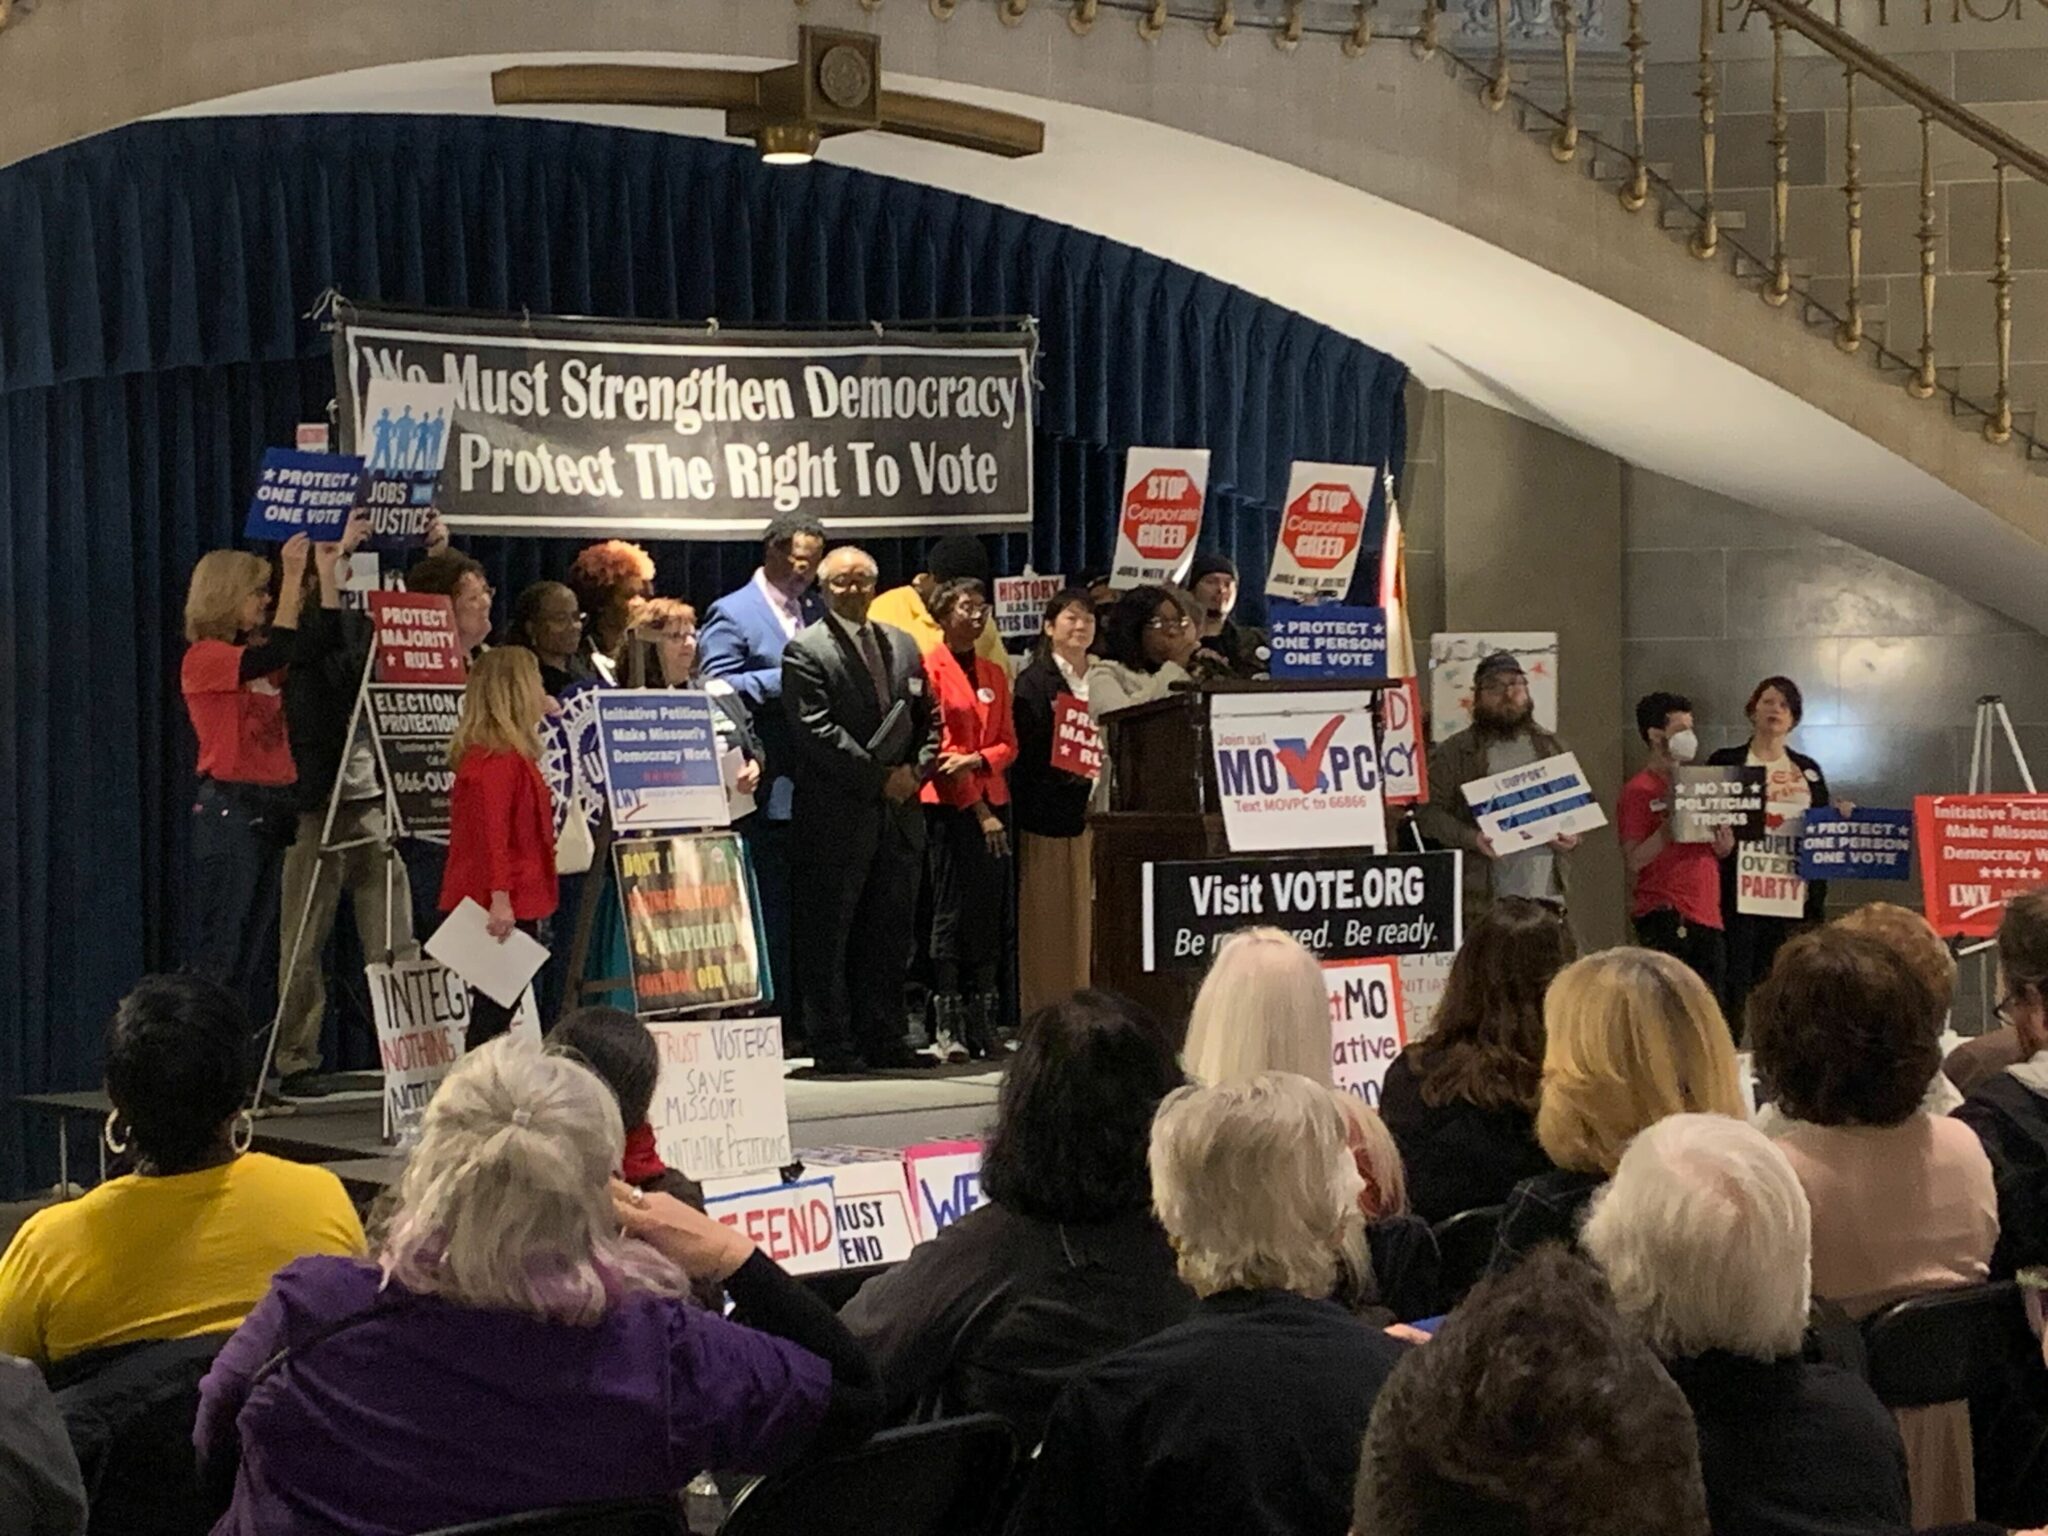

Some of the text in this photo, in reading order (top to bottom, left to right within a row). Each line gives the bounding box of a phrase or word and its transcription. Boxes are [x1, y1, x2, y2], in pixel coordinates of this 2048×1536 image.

[444, 352, 550, 417] Must
[561, 359, 795, 435] Strengthen
[804, 365, 1018, 430] Democracy
[278, 468, 350, 488] PROTECT
[459, 433, 997, 512] Protect The Right To Vote
[257, 485, 355, 506] ONE PERSON
[366, 480, 408, 505] JOBS
[1146, 475, 1190, 500] STOP
[1307, 490, 1351, 513] STOP
[264, 504, 343, 524] ONE VOTE
[369, 507, 432, 535] JUSTICE
[1127, 503, 1200, 523] Corporate
[1286, 515, 1360, 535] Corporate
[998, 580, 1059, 601] HISTORY
[382, 607, 447, 627] PROTECT
[1288, 621, 1369, 635] PROTECT
[381, 629, 454, 648] MAJORITY
[1272, 636, 1385, 650] ONE PERSON
[404, 651, 444, 669] RULE
[1284, 652, 1375, 666] ONE VOTE
[374, 693, 456, 712] ELECTION
[380, 714, 459, 733] PROTECTION
[1217, 732, 1267, 747] Join us!
[1694, 782, 1743, 795] NO TO
[1234, 799, 1262, 813] Text
[1264, 797, 1309, 811] MOVPC
[1313, 798, 1326, 810] to
[1675, 797, 1762, 811] POLITICIAN
[1935, 805, 2006, 820] Initiative
[1691, 812, 1748, 826] TRICKS
[1818, 822, 1895, 835] PROTECT
[1945, 824, 1988, 839] Make
[1803, 836, 1910, 850] ONE PERSON
[1812, 851, 1897, 865] ONE VOTE
[1943, 846, 2031, 864] Democracy
[1189, 866, 1424, 916] Visit VOTE.ORG
[1741, 875, 1801, 900] PARTY
[1174, 928, 1205, 957] Be
[1344, 919, 1371, 947] Be
[1376, 913, 1438, 949] ready.
[380, 966, 472, 1029] INTEG
[382, 1027, 456, 1073] NOTHING
[687, 1068, 736, 1095] SAVE
